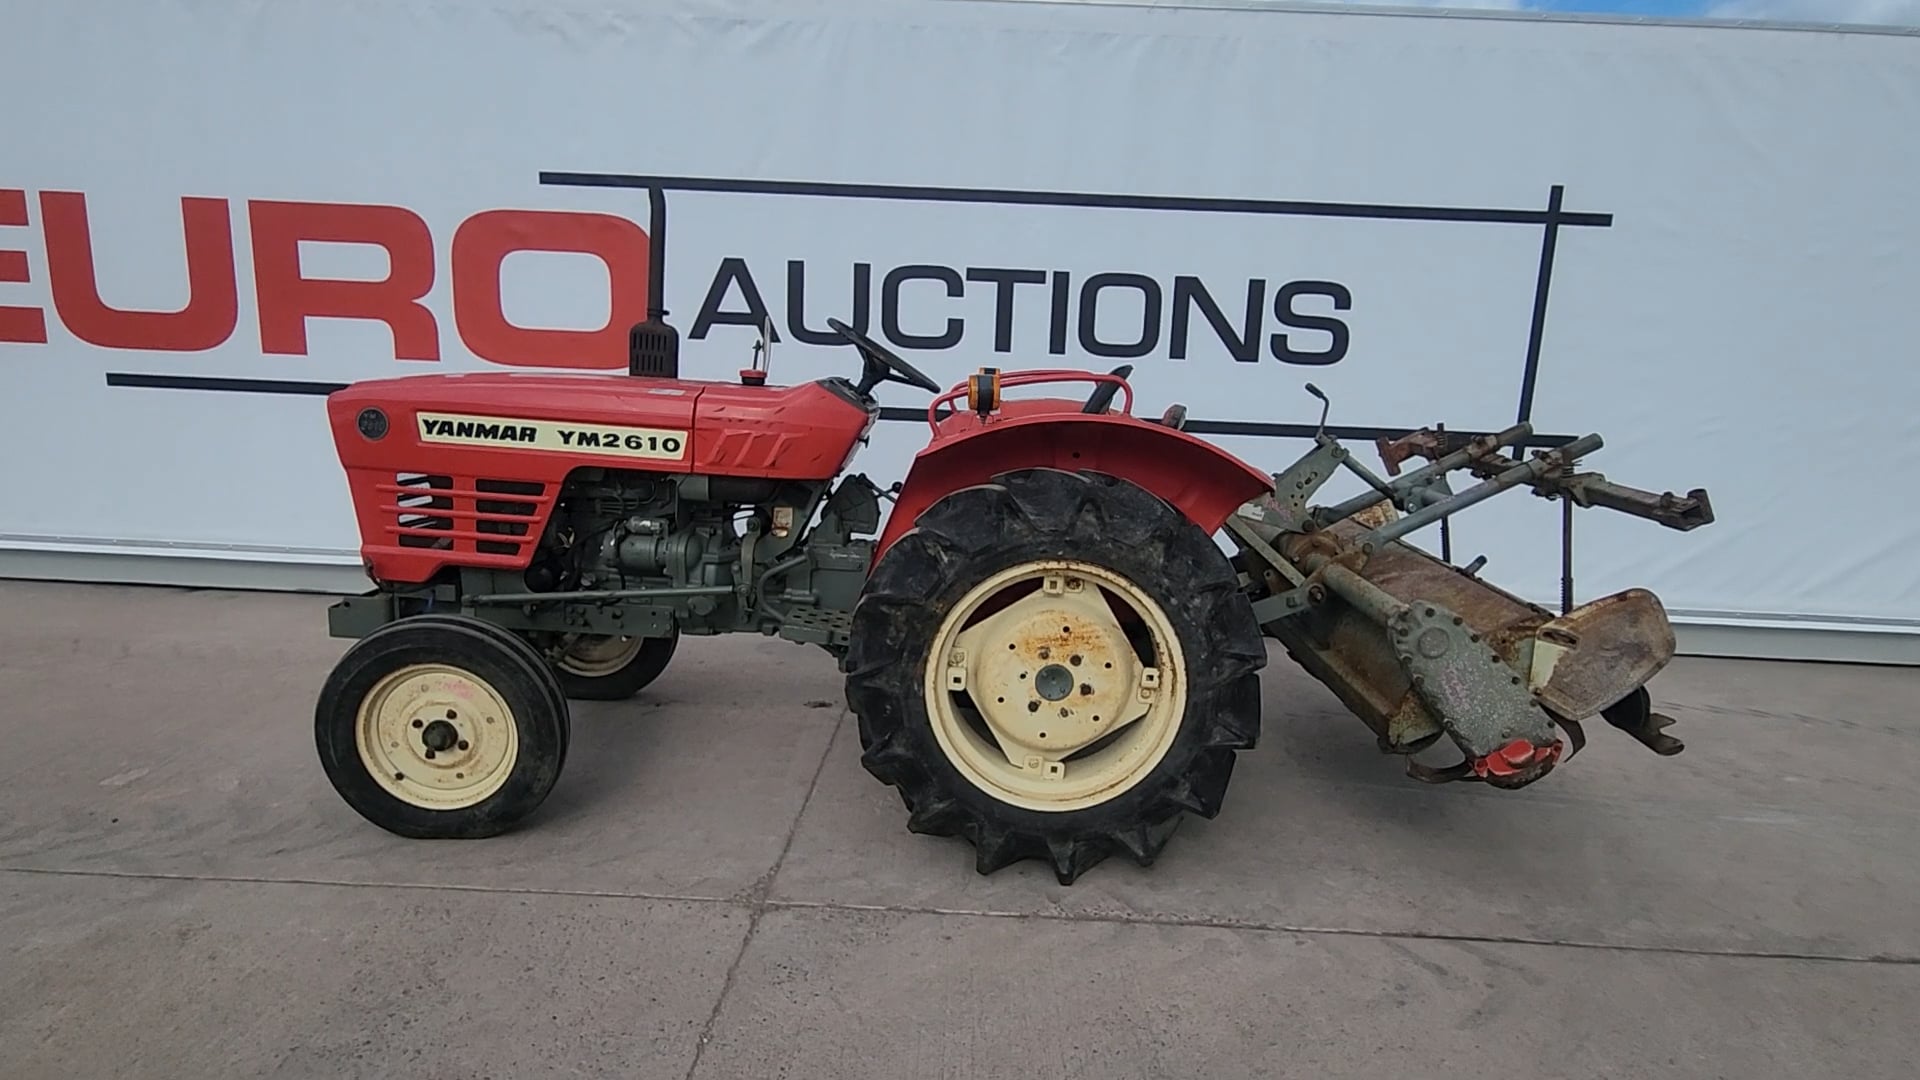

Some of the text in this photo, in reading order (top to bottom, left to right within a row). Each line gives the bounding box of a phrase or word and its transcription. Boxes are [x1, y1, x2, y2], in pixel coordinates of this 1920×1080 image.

[688, 257, 1353, 366] AUCTIONS
[422, 419, 681, 453] YANMAR YM2610
